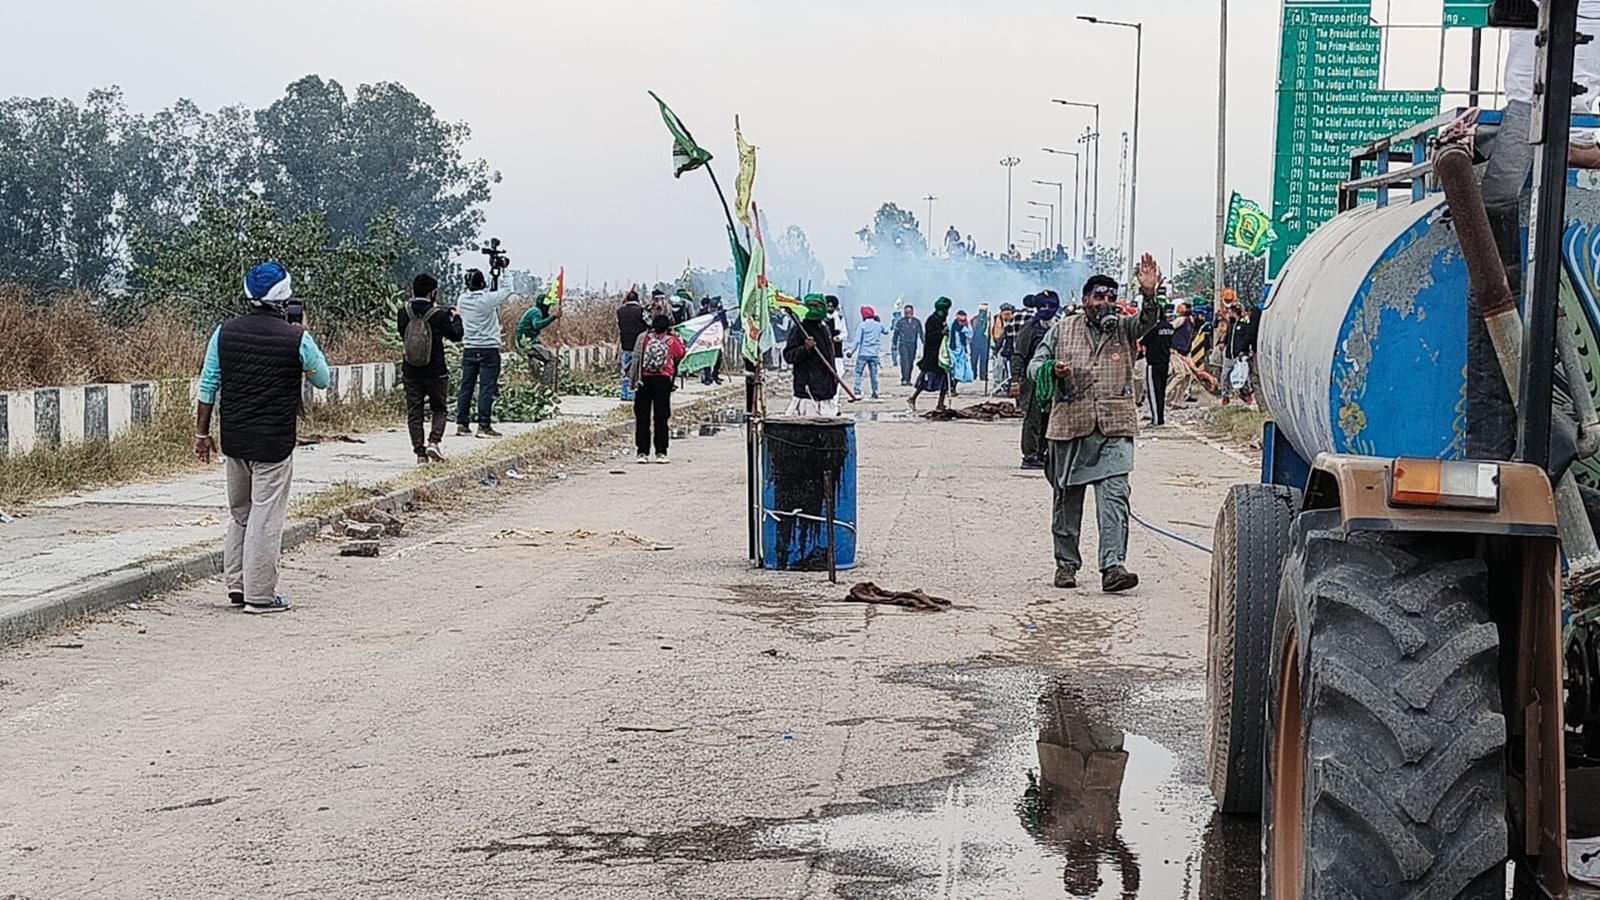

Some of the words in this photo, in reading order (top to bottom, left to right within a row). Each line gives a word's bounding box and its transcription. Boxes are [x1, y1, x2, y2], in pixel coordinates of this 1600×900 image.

[1292, 12, 1304, 26] (a)
[1310, 12, 1369, 25] Transporting
[1299, 28, 1309, 40] (1)
[1316, 28, 1328, 38] The
[1329, 28, 1360, 39] President
[1361, 28, 1369, 38] of
[1316, 41, 1327, 51] The
[1315, 54, 1326, 64] The
[1328, 54, 1345, 64] Chief
[1346, 54, 1369, 64] Justice
[1371, 54, 1378, 64] of
[1314, 67, 1325, 77] The
[1327, 67, 1352, 77] Cabinet
[1313, 80, 1325, 90] The
[1326, 80, 1345, 91] Judge
[1347, 80, 1354, 90] of
[1356, 80, 1367, 90] The
[1313, 92, 1324, 102] The
[1326, 92, 1360, 102] Lieutenant
[1361, 93, 1390, 102] Governor
[1391, 93, 1399, 102] of
[1406, 92, 1425, 102] Union
[1313, 105, 1324, 115] The
[1326, 105, 1356, 115] Chairman
[1357, 105, 1365, 115] of
[1365, 105, 1375, 115] the
[1377, 106, 1412, 117] Legislative
[1413, 106, 1438, 116] Council
[1312, 117, 1324, 128] The
[1325, 117, 1343, 128] Chief
[1343, 118, 1367, 128] Justice
[1368, 118, 1376, 128] of
[1382, 118, 1397, 130] High
[1312, 130, 1323, 140] The
[1325, 130, 1349, 140] Member
[1351, 130, 1358, 140] of
[1311, 143, 1322, 153] The
[1323, 143, 1340, 155] Army
[1310, 157, 1321, 166] The
[1323, 157, 1340, 166] Chief
[1309, 169, 1321, 179] The
[1308, 182, 1320, 192] The
[1308, 194, 1319, 204] The
[1307, 207, 1318, 217] The
[1306, 221, 1318, 230] The
